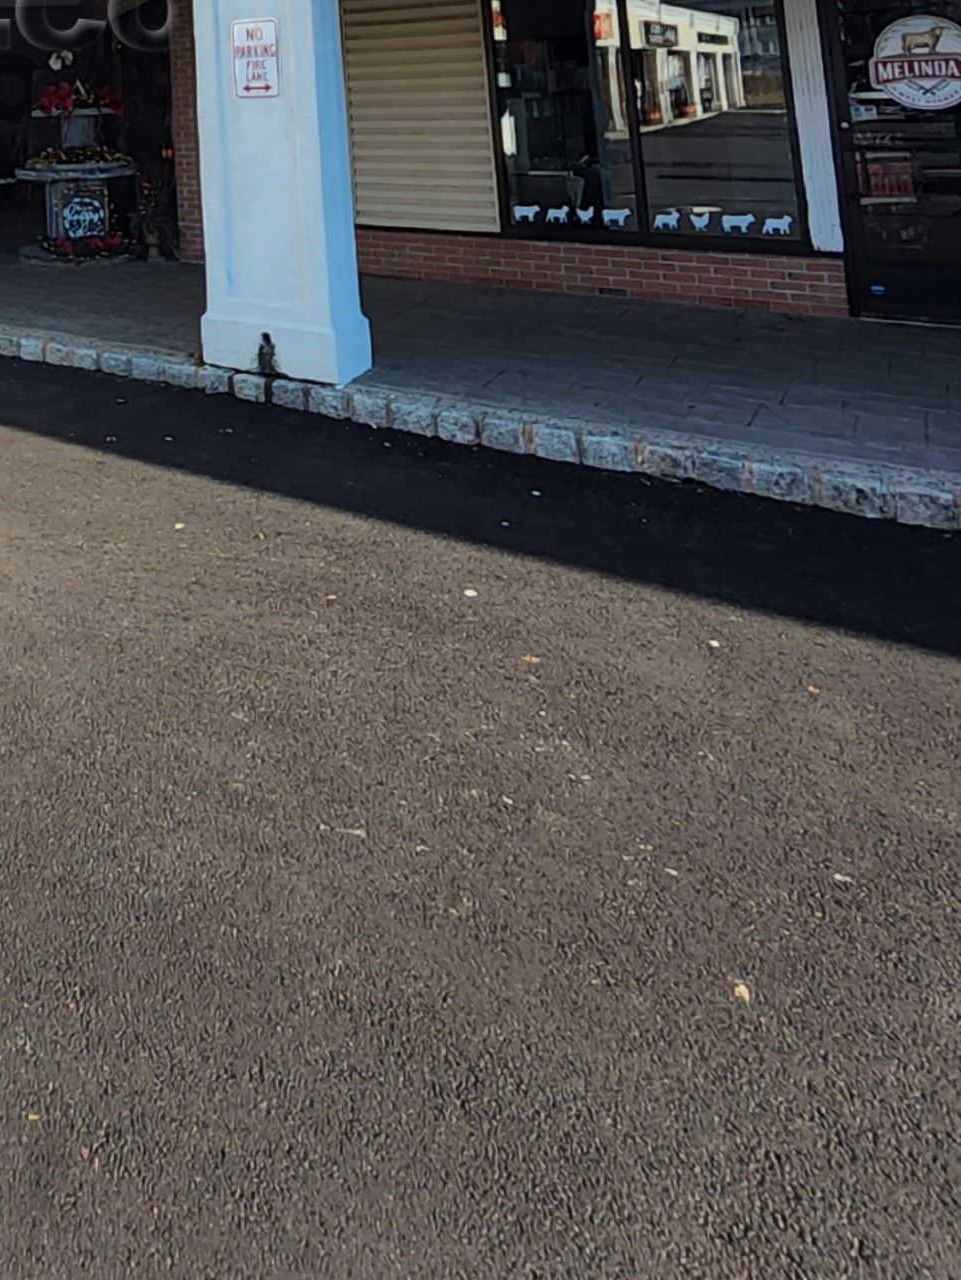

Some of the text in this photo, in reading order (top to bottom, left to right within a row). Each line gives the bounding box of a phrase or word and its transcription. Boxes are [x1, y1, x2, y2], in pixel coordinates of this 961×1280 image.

[246, 27, 263, 41] NO
[235, 43, 276, 58] PARKING
[246, 60, 266, 70] FIRE
[877, 60, 961, 82] MELINDA
[245, 71, 268, 82] LANE
